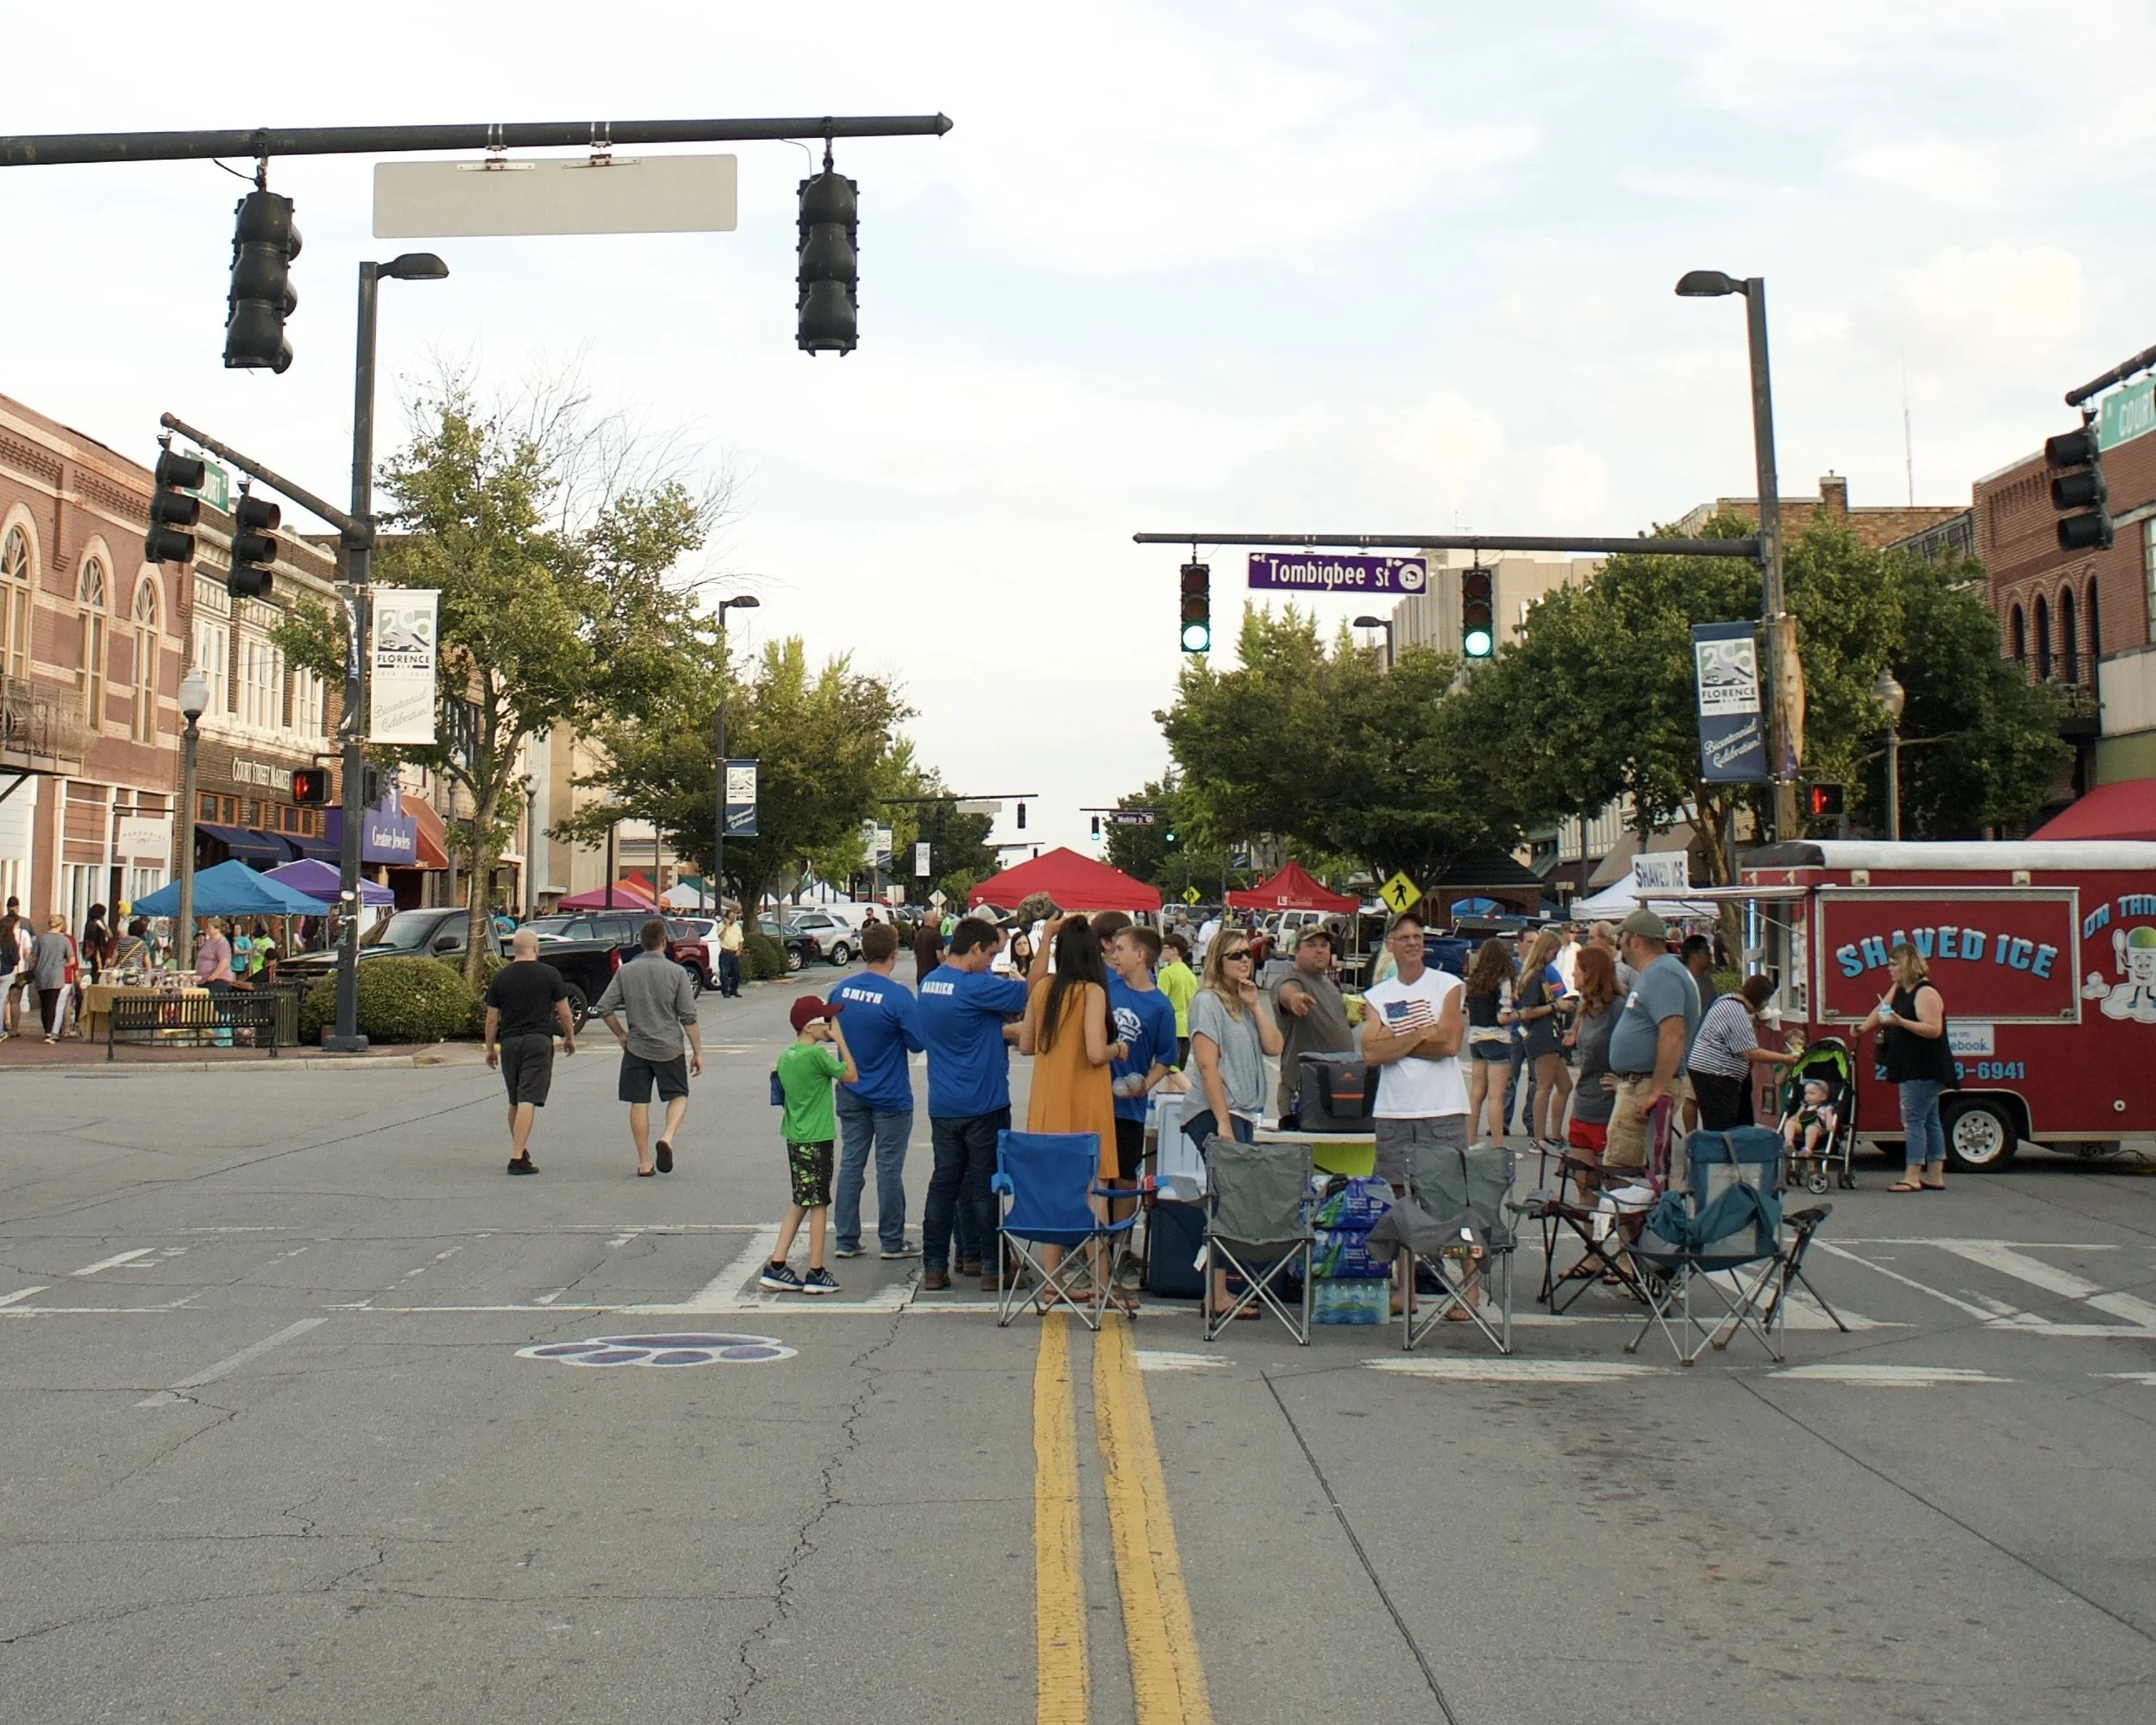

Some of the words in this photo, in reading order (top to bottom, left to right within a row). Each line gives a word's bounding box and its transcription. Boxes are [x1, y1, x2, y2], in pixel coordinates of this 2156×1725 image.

[1269, 559, 1366, 591] Tombigbee
[1376, 566, 1390, 587] St
[377, 654, 430, 664] FLORENCE
[373, 686, 428, 719] Bicentennial
[1702, 687, 1757, 699] FLORENCE
[380, 700, 430, 733] Celebration!
[1704, 717, 1758, 756] Bicentennial
[1713, 731, 1761, 768] Celebration!
[372, 825, 392, 848] Creative
[392, 827, 411, 850] Jewelers
[2083, 903, 2110, 939] ON
[1995, 933, 2059, 979] ICE
[841, 987, 884, 1005] SMITH
